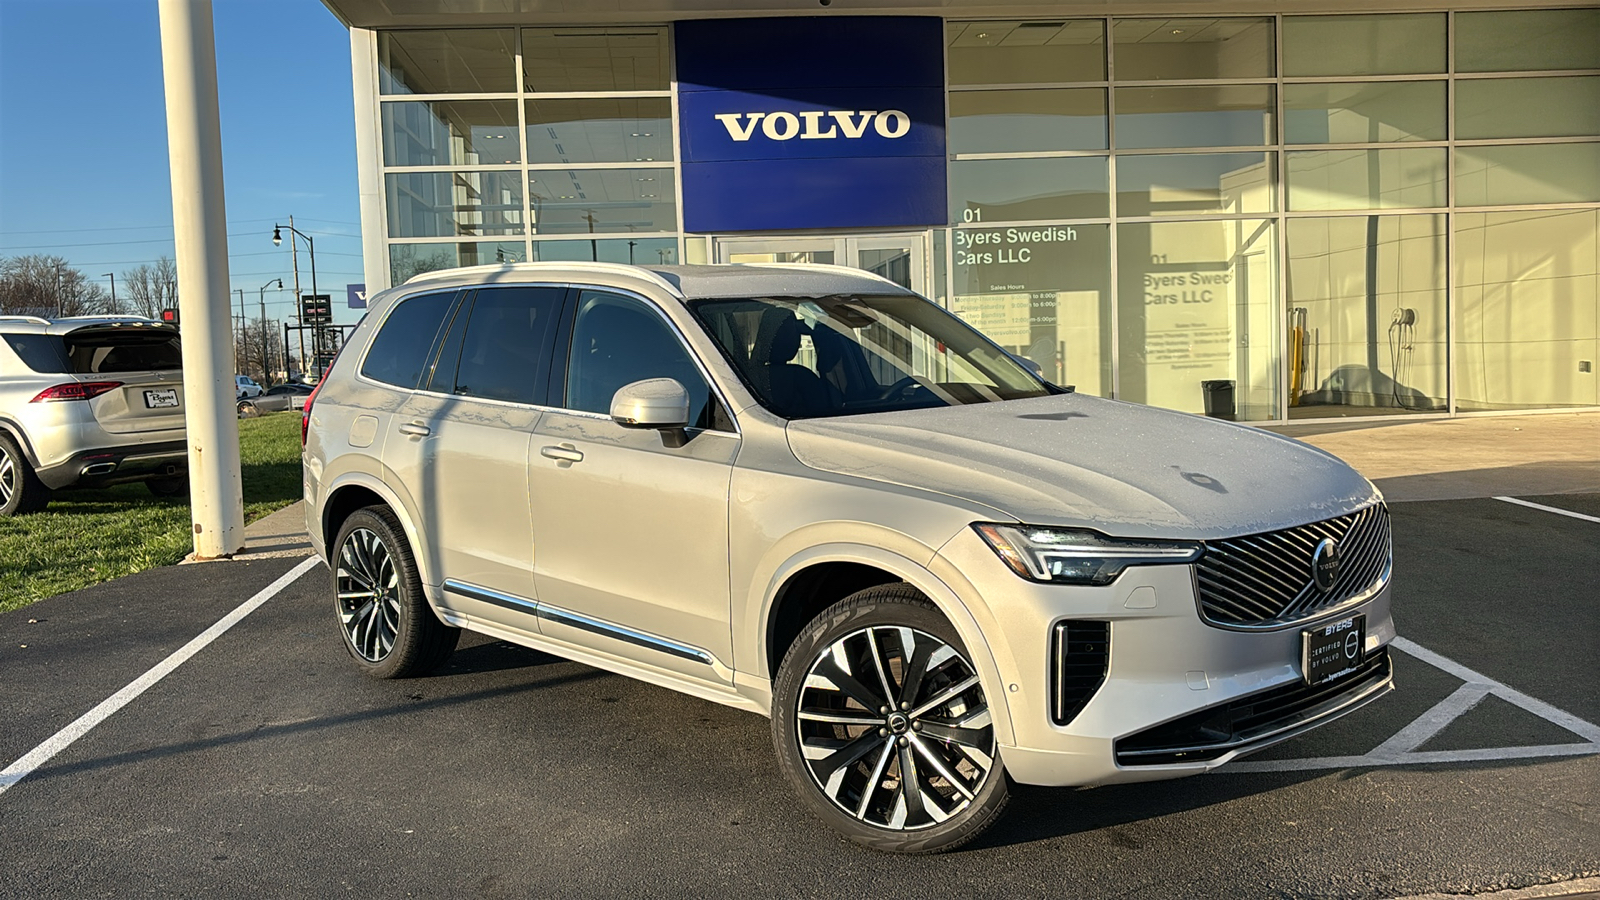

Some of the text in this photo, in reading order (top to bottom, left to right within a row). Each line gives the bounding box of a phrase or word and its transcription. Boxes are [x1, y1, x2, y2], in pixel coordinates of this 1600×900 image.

[715, 109, 911, 142] VOLVO
[963, 207, 981, 223] 01
[956, 226, 1077, 249] Byers Swedish
[957, 248, 1031, 265] Cars LLC
[990, 283, 1025, 292] Sales Hours
[1182, 289, 1213, 304] LLC
[1325, 618, 1353, 636] BYERS
[1312, 640, 1341, 657] CERTIFIED
[1321, 652, 1340, 664] VOLVO
